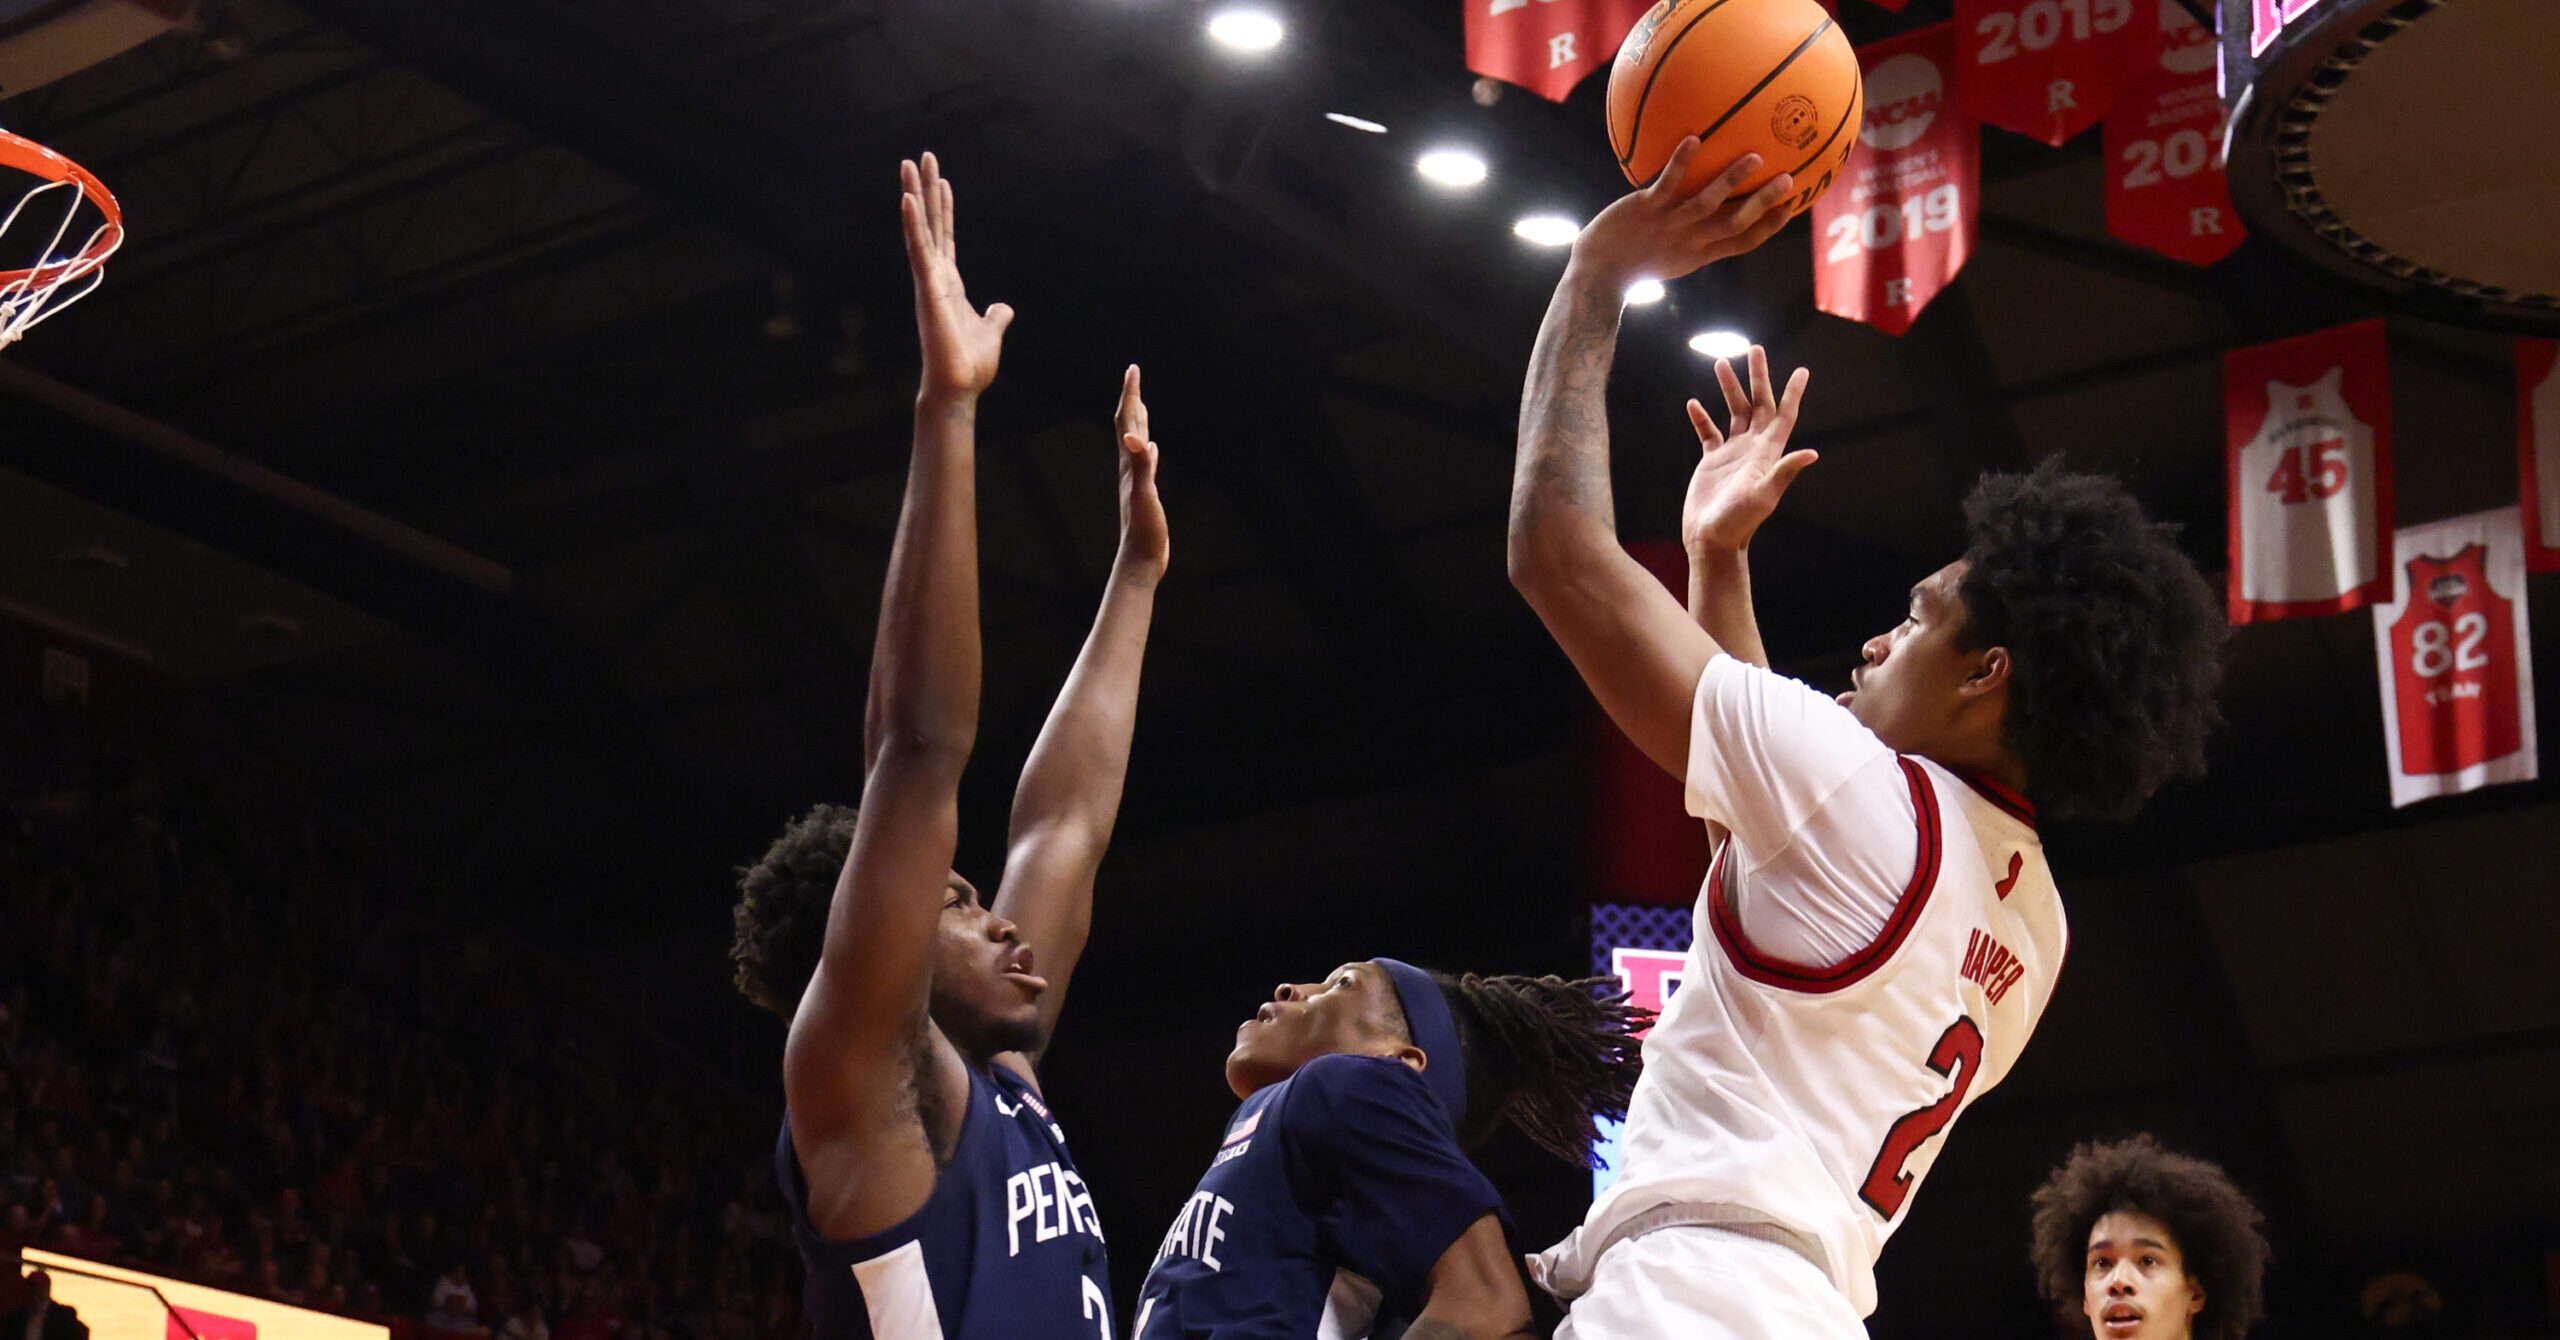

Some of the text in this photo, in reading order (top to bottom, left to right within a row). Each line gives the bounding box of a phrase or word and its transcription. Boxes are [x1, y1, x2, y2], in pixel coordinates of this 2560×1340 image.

[1548, 32, 1578, 69] R
[1976, 0, 2133, 65] 2015
[2048, 79, 2078, 114] R
[1826, 183, 1959, 263] 2019
[2190, 207, 2224, 237] R
[1886, 277, 1914, 307] R
[2266, 437, 2347, 506] 45
[2412, 612, 2489, 678] 82
[1960, 927, 2025, 1006] HARPER
[1858, 1014, 1984, 1222] 2
